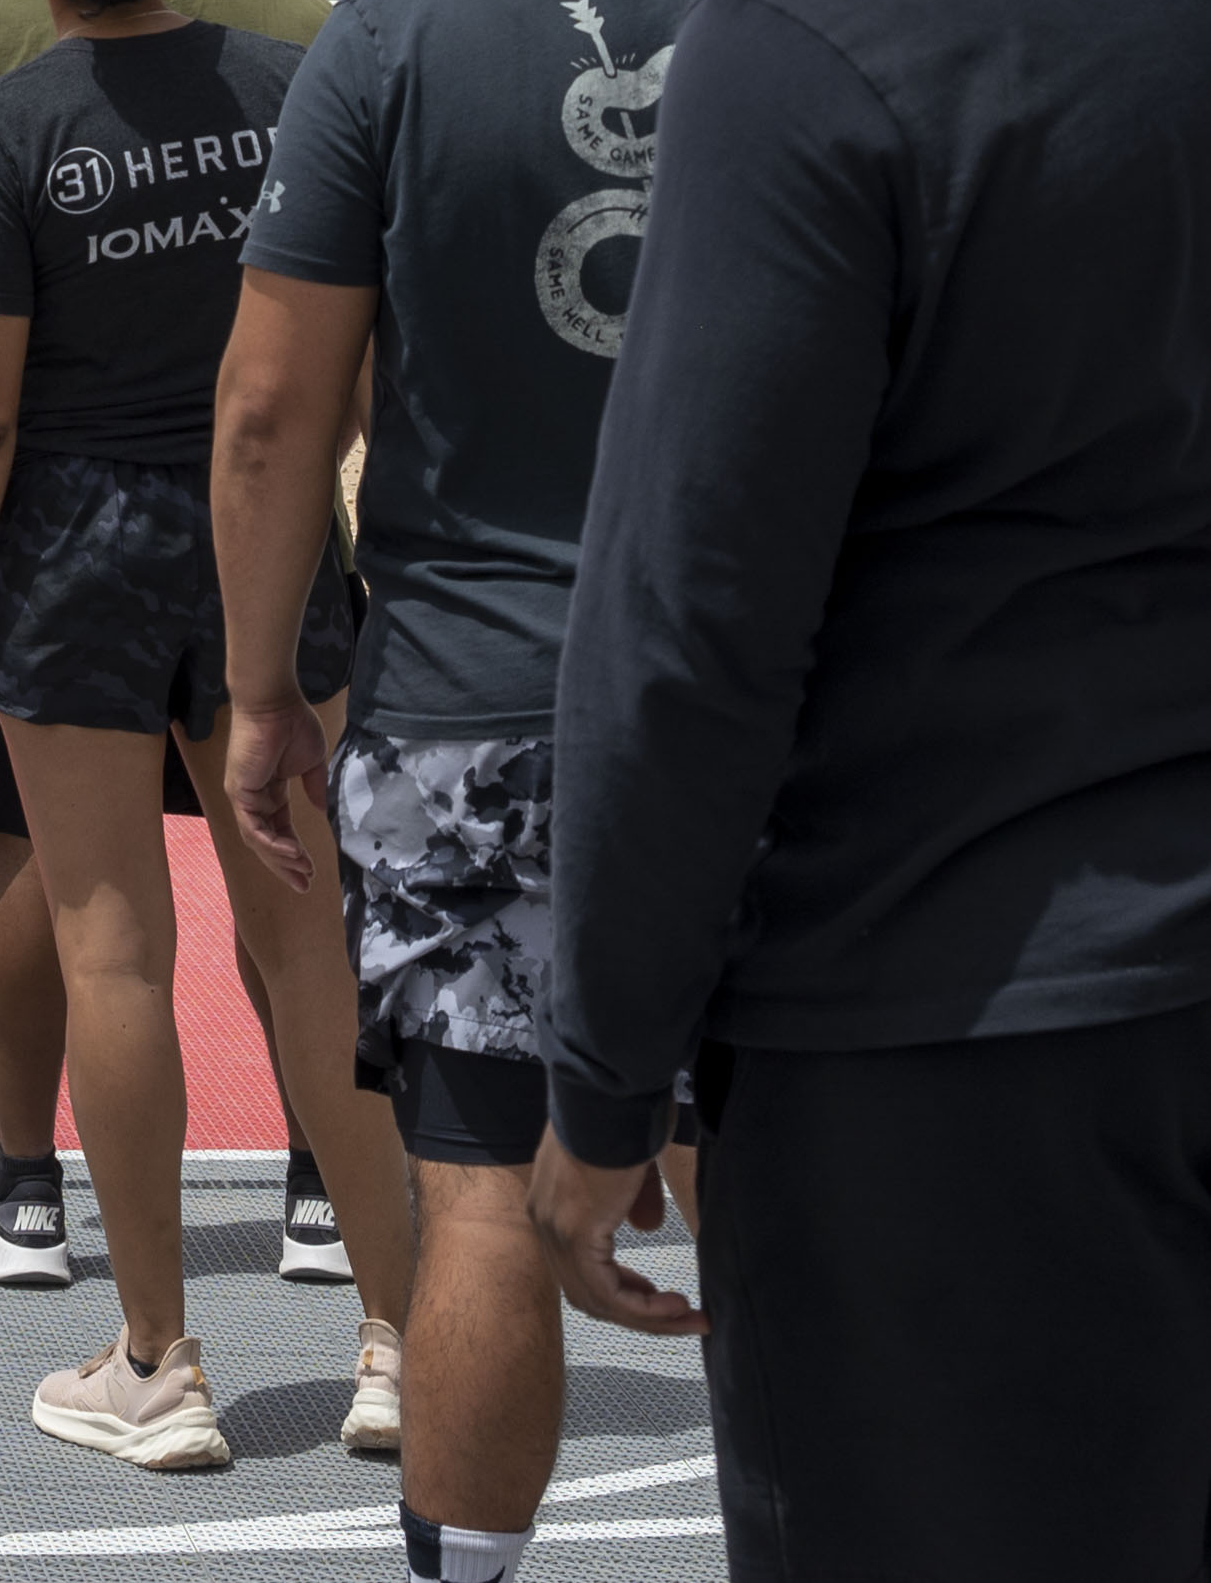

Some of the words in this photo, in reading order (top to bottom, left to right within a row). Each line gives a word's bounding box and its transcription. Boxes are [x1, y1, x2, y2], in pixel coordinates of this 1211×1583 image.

[576, 94, 603, 151] SAME
[610, 147, 655, 165] GAME
[56, 157, 104, 203] 31
[549, 247, 566, 301] SAME
[562, 307, 605, 344] HELL
[13, 1206, 60, 1232] NIKE
